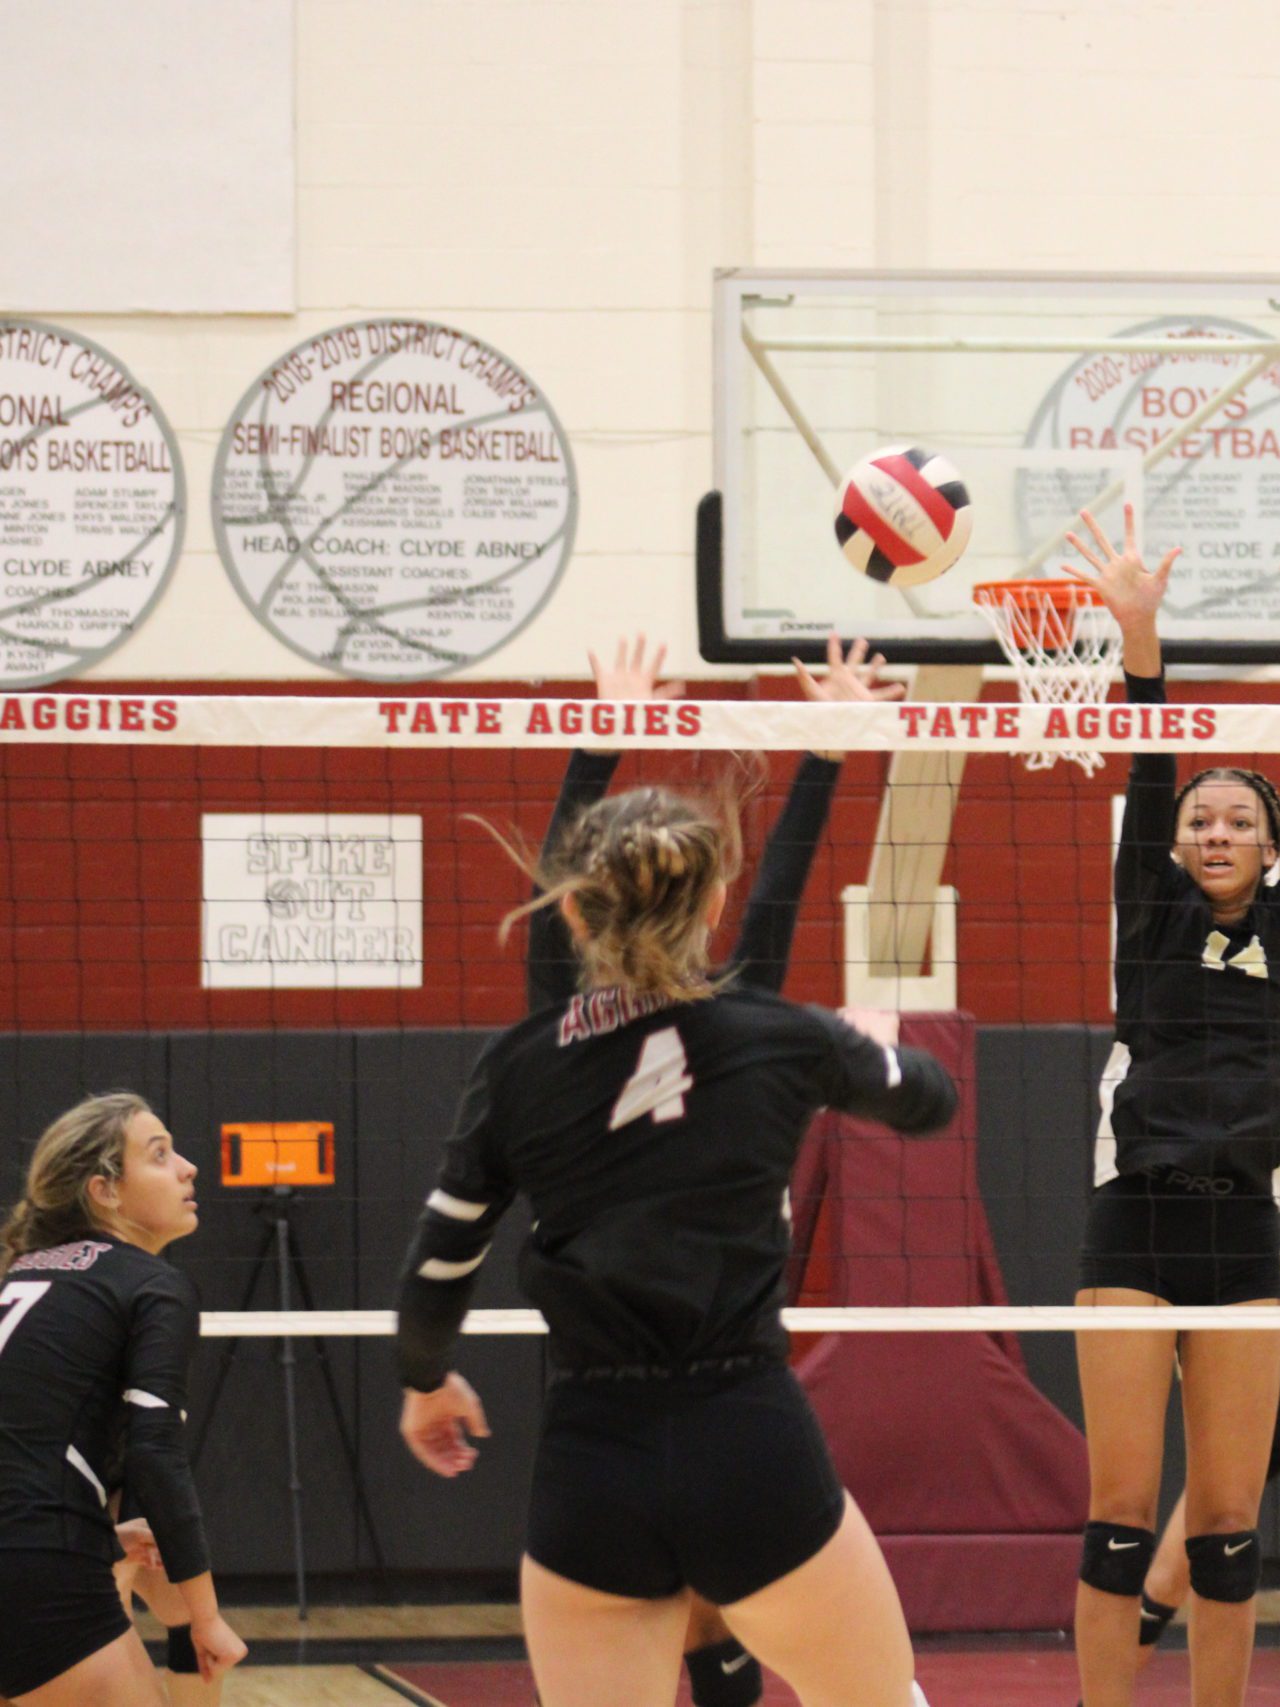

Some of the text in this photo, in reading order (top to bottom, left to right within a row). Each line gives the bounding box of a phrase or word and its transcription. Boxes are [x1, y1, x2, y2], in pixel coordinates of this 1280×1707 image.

[0, 328, 151, 428] TRICT CHAMPS
[263, 321, 537, 414] 2018-2019 DISTRICT CHAMPS
[330, 380, 465, 415] REGIONAL
[48, 440, 172, 474] BASKETBALL
[233, 423, 560, 462] SEMI-FINALIST BOYS BASKETBALL
[243, 536, 547, 560] HEAD COACH: CLYDE ABNEY
[1199, 542, 1262, 559] CLYDE
[4, 559, 153, 577] CLYDE ABNEY
[0, 699, 179, 731] AGGIES
[378, 702, 701, 736] TATE AGGIES
[899, 706, 1217, 739] TATE AGGIES
[247, 833, 391, 876] SPIKE
[219, 924, 416, 967] CANCER
[609, 1025, 693, 1131] 4
